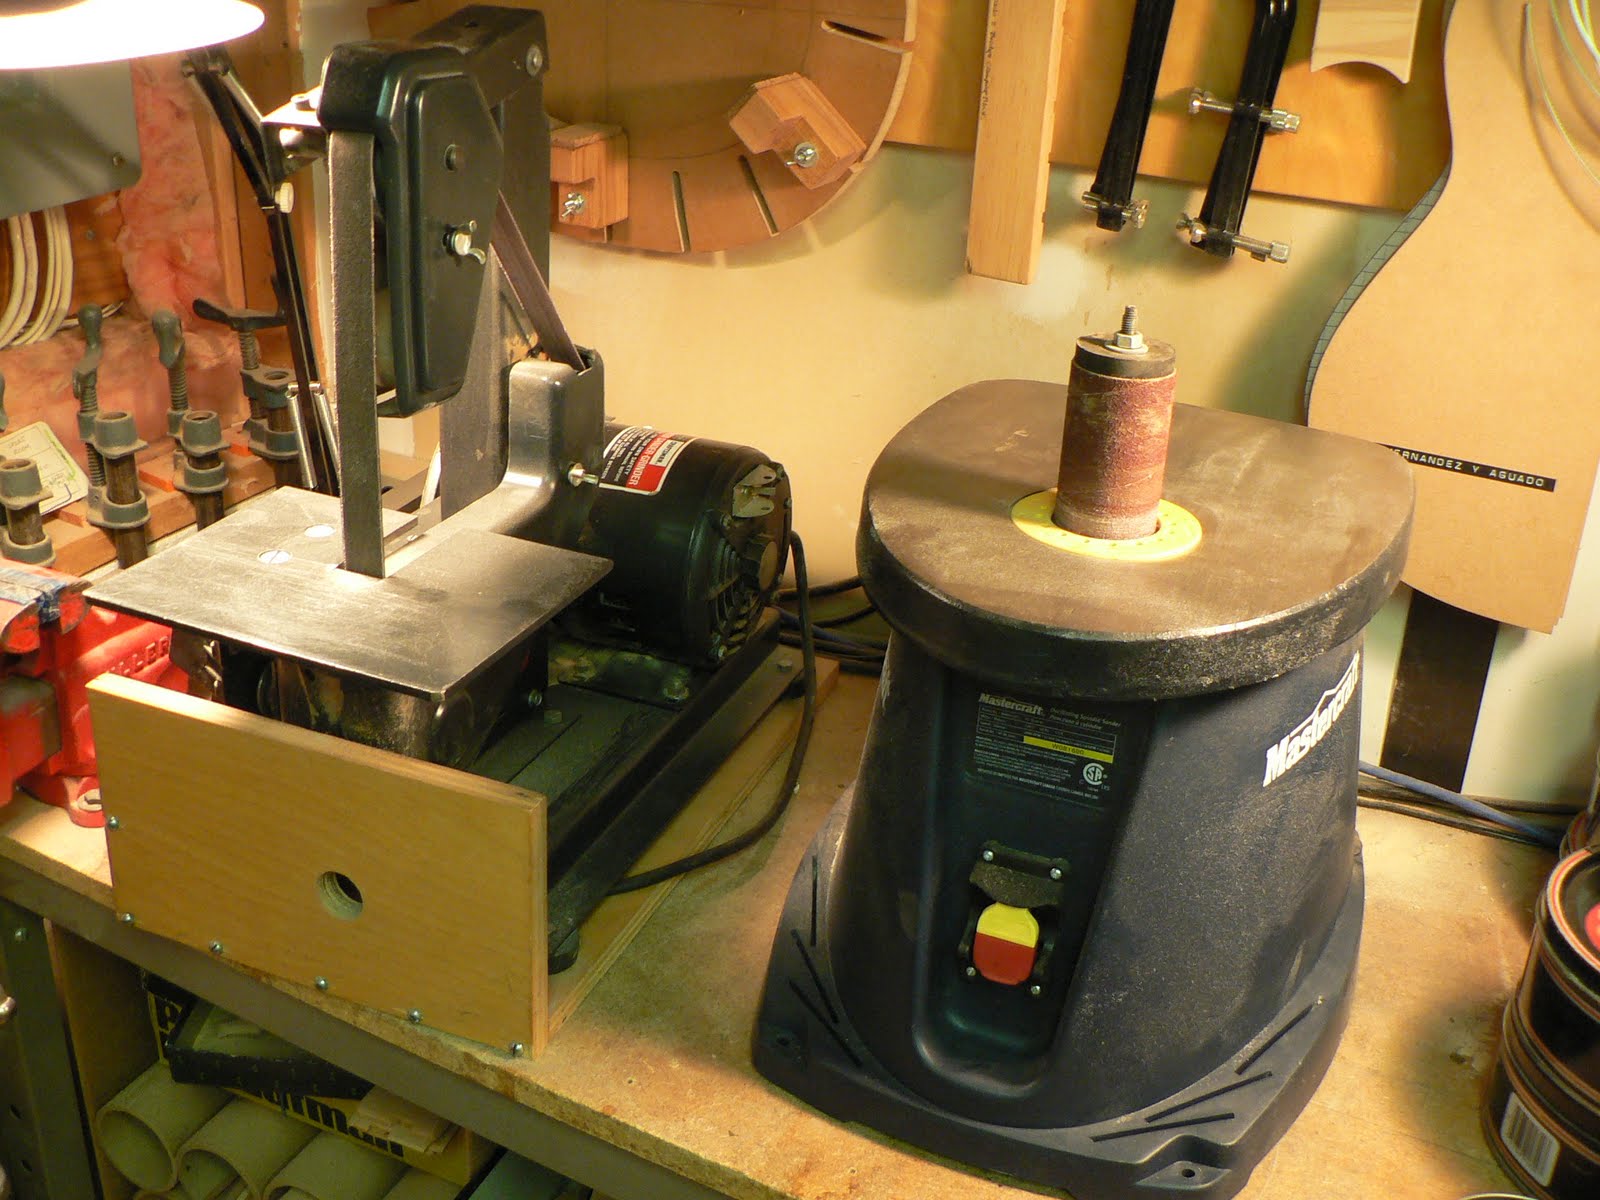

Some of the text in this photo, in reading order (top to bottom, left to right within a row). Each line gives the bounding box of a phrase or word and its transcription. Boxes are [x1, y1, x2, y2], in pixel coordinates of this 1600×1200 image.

[1391, 449, 1544, 487] RNANDEZ Y AGUADO
[979, 693, 1044, 715] Mastercraft
